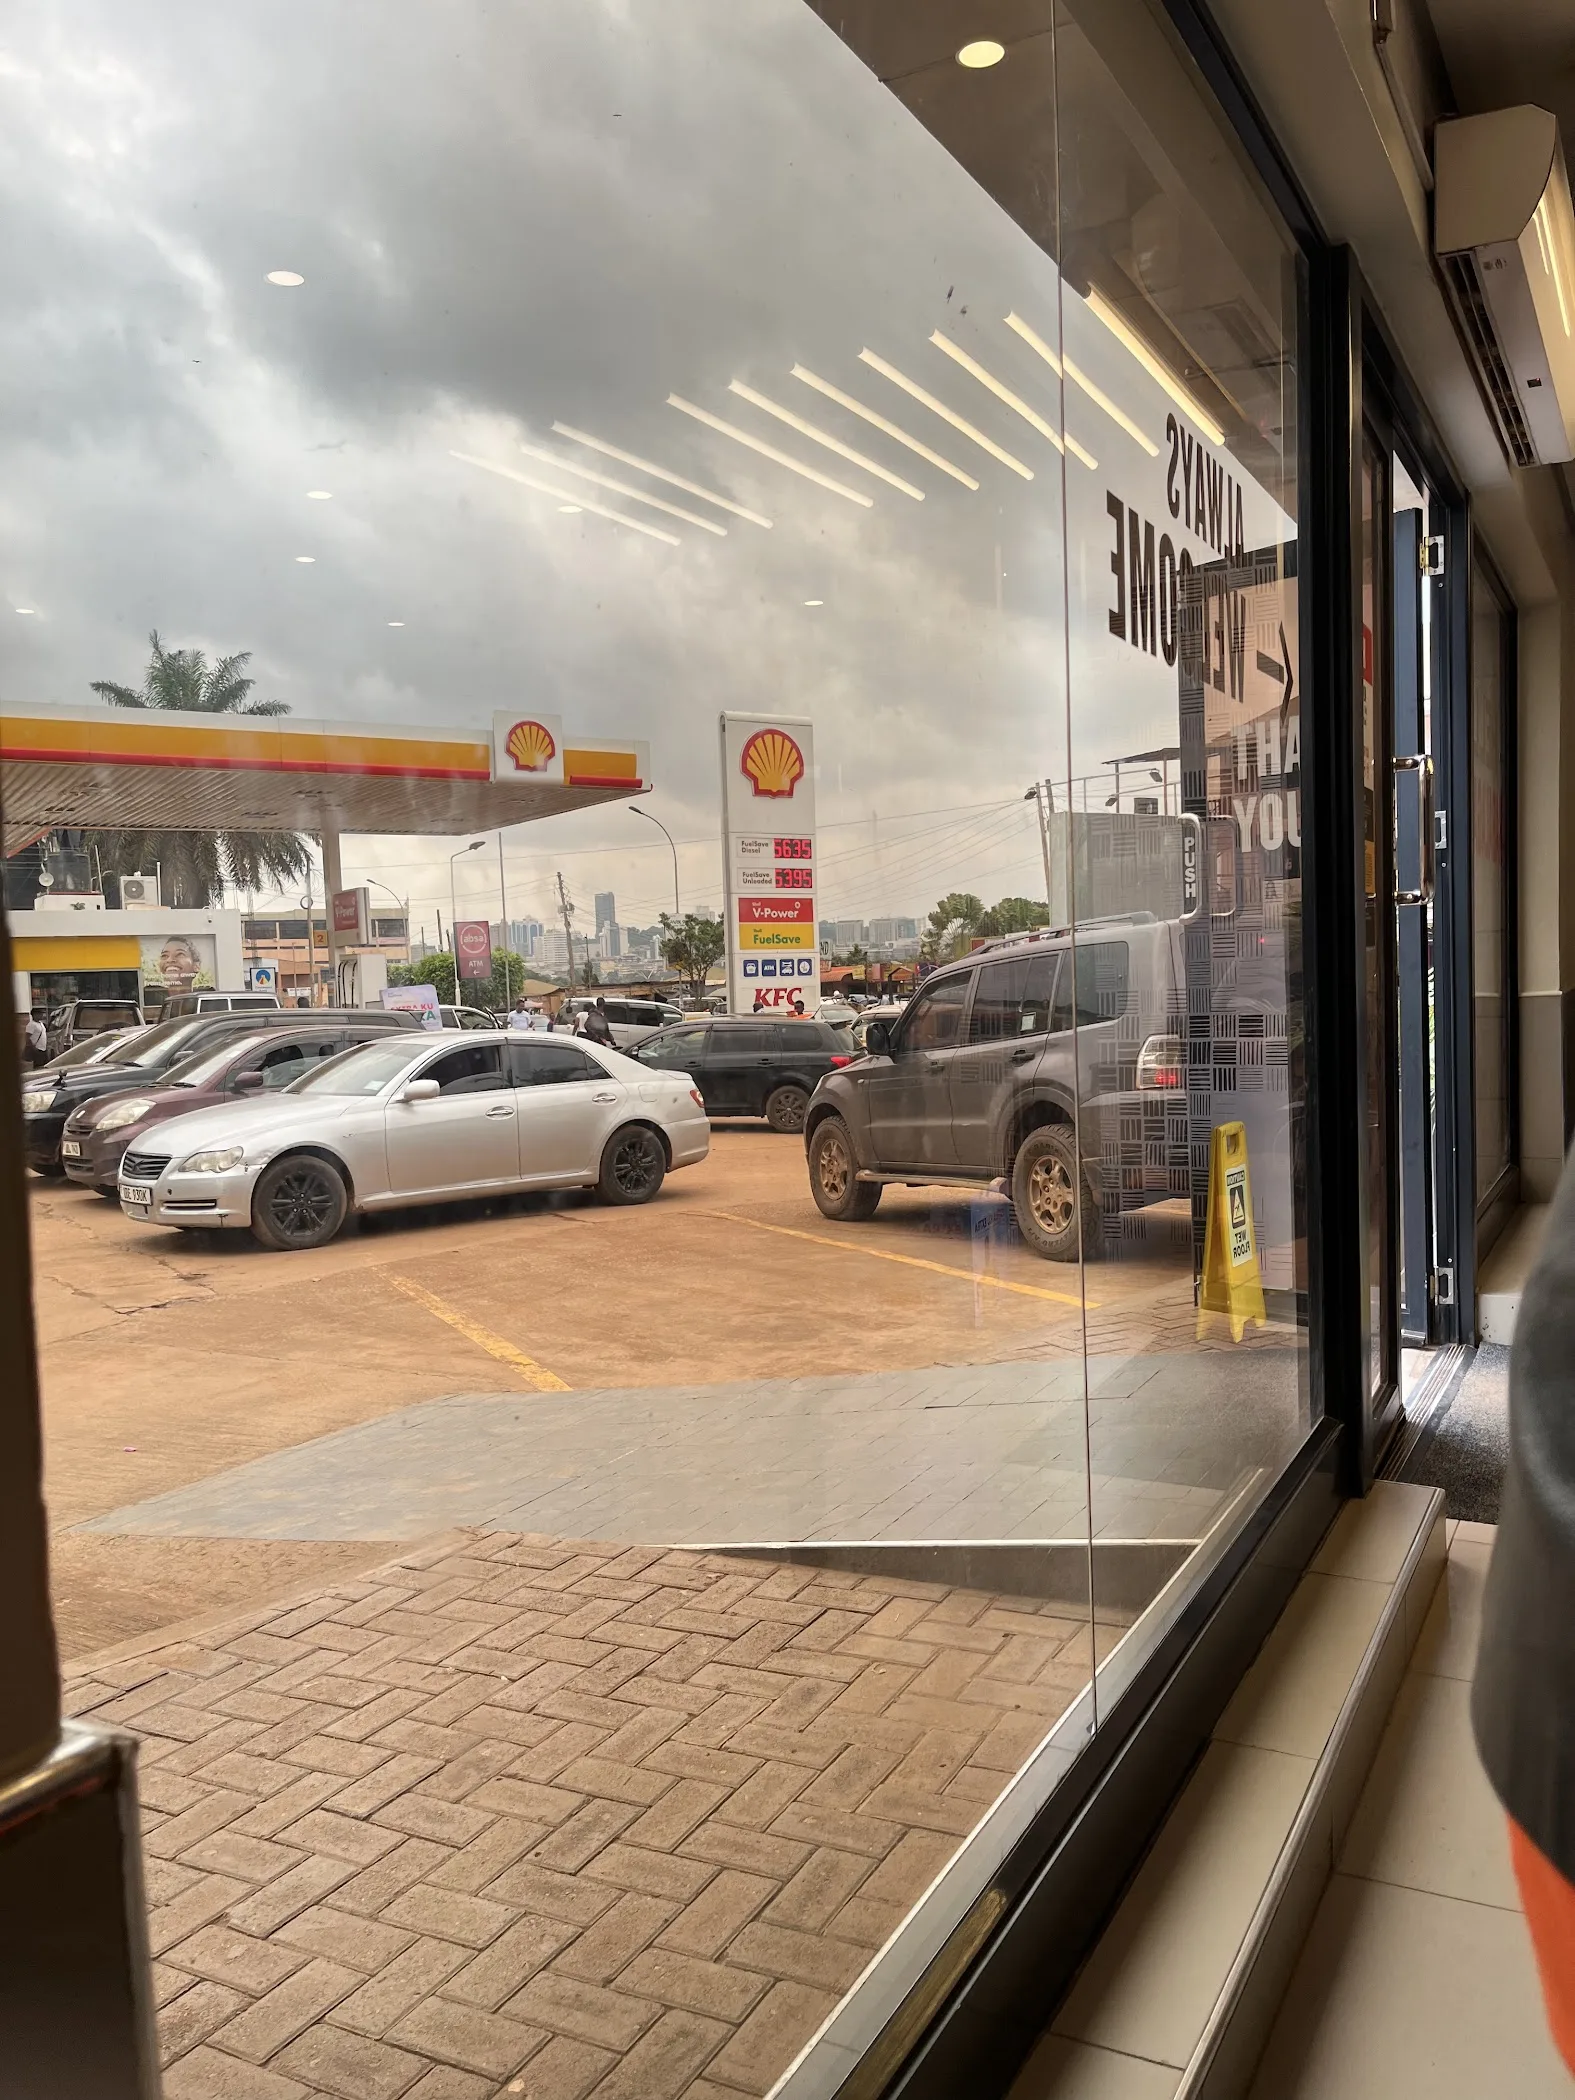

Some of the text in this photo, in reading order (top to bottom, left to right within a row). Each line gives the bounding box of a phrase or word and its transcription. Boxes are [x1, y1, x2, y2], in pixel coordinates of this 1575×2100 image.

[773, 838, 812, 859] 5635
[1184, 836, 1197, 899] PUSH
[775, 869, 812, 888] 5395
[752, 907, 799, 919] V-Power
[317, 934, 324, 943] 2
[463, 933, 484, 943] absa
[753, 933, 801, 945] FuelSave
[468, 960, 484, 968] ATM
[754, 987, 802, 1007] KFC
